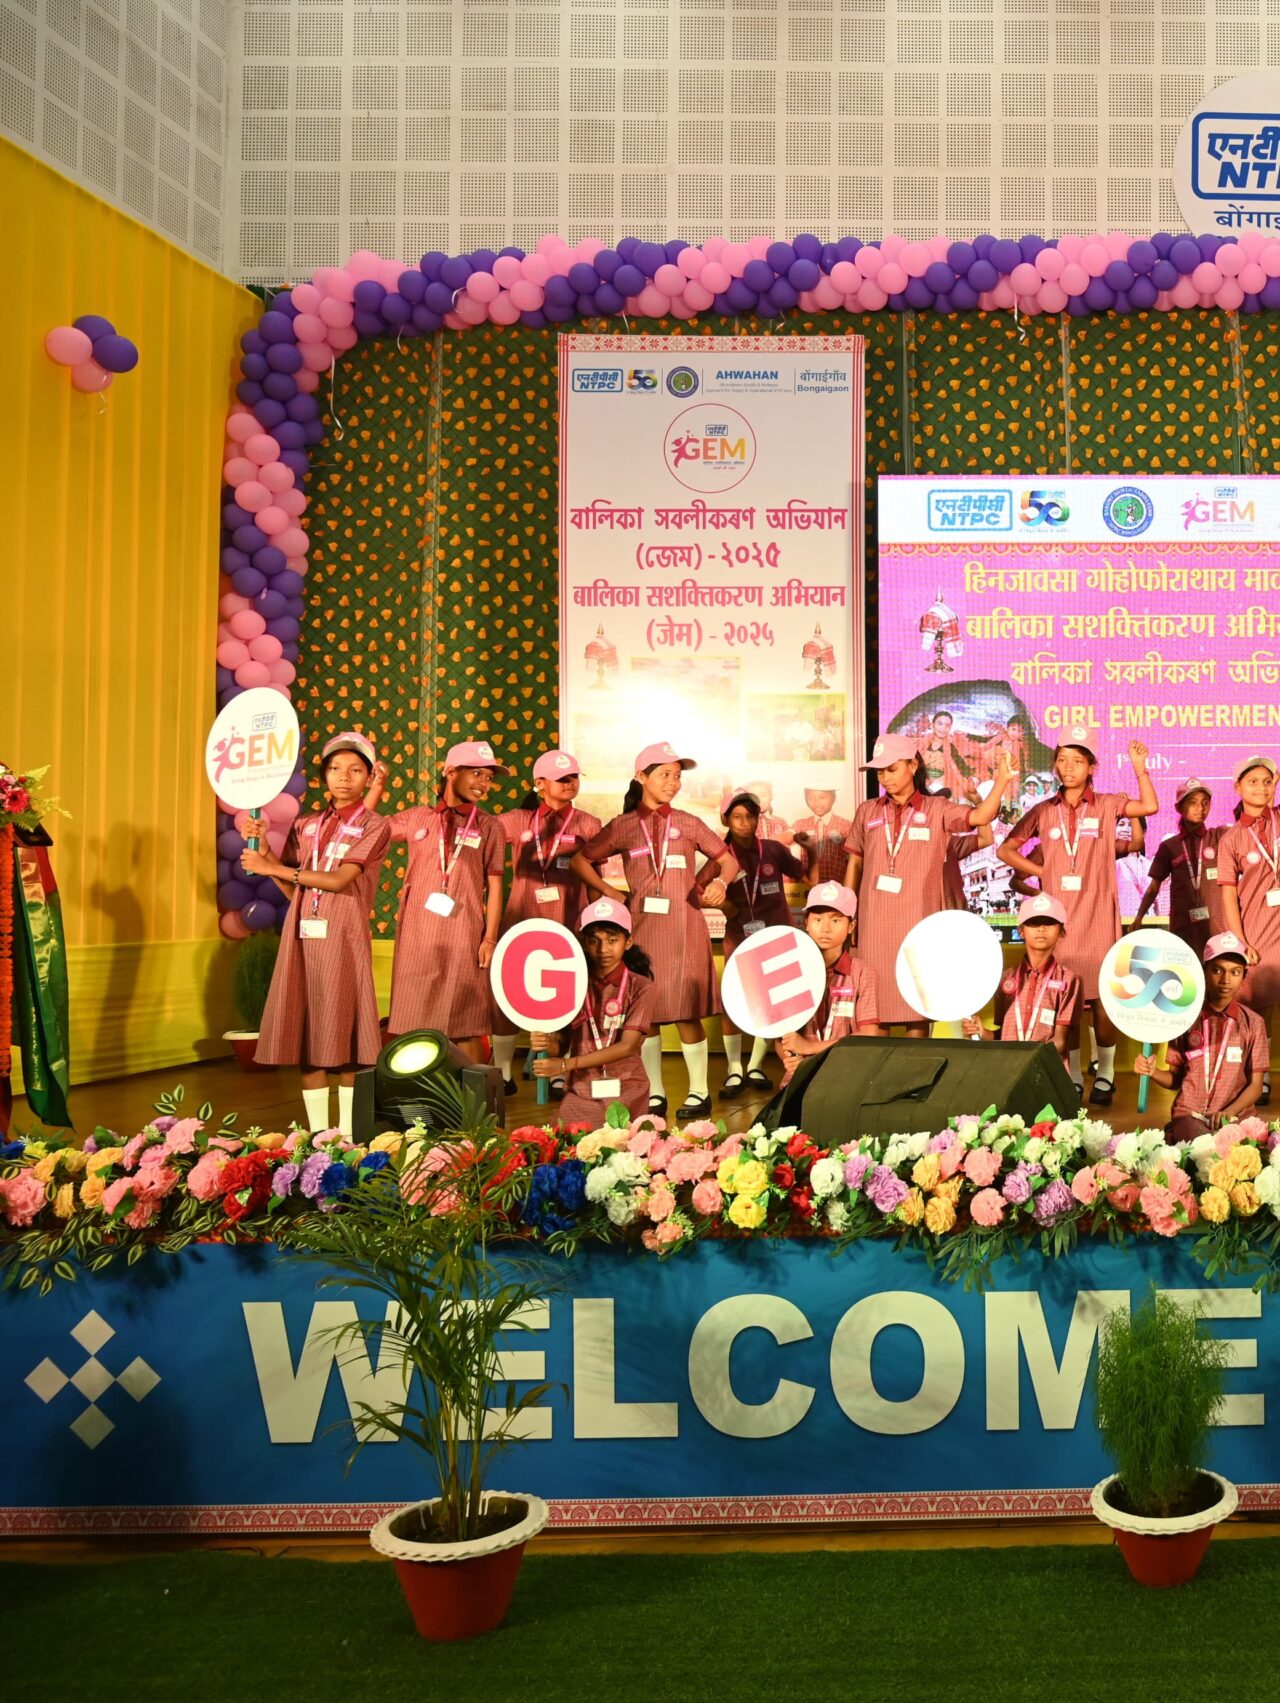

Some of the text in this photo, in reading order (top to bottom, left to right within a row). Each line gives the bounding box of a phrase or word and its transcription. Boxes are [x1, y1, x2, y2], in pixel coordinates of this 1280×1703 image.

[576, 371, 619, 382] एनटीपीसी
[579, 381, 616, 390] NTPC
[715, 370, 779, 380] AHWAHAN
[797, 384, 849, 394] Bongaigaon
[680, 437, 746, 460] GEM
[570, 499, 848, 530] বালিকা সবলীকৰণ অভিযান
[935, 495, 1005, 511] एनटीपीसी
[1192, 500, 1255, 523] GEM
[940, 512, 1000, 526] NTPC
[636, 542, 702, 570] (জেম)
[721, 542, 781, 568] ২০২৫
[964, 560, 1078, 594] हिनजावसा
[573, 578, 846, 607] बालिका सशक्तिकरण अभियान
[646, 615, 702, 651] (जेम)
[724, 621, 774, 647] २०२५
[965, 606, 1054, 639] बालिका
[1061, 606, 1216, 639] सशक्तिकरण
[1011, 651, 1093, 685] বালিকা
[1104, 651, 1217, 685] সবলীকৰণ
[1044, 705, 1101, 728] GIRL
[226, 729, 295, 770] GEM
[1141, 753, 1172, 772] uly
[501, 930, 576, 1020] G
[734, 931, 815, 1029] E
[242, 1287, 1266, 1445] WELCOME
